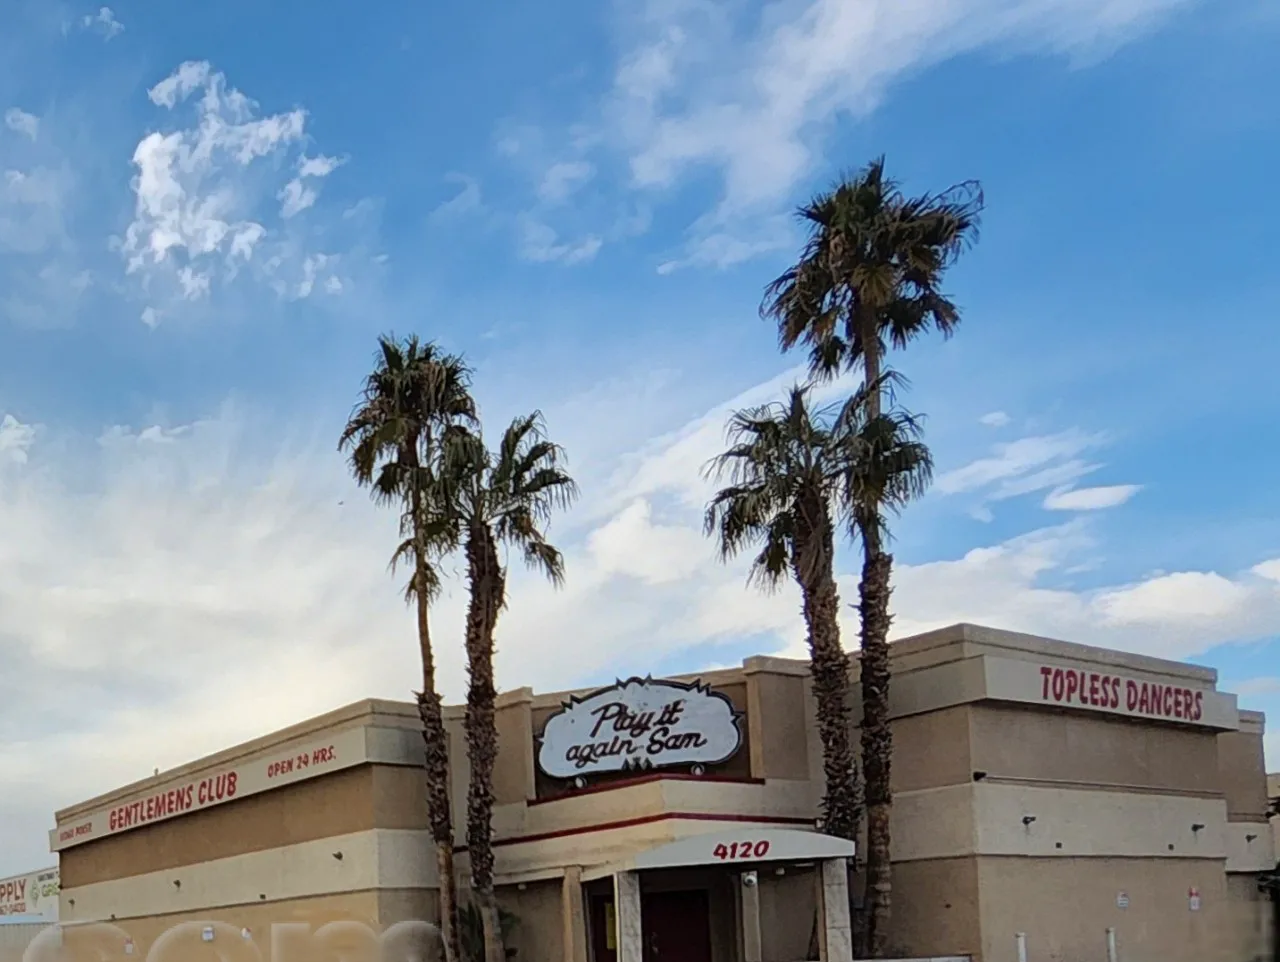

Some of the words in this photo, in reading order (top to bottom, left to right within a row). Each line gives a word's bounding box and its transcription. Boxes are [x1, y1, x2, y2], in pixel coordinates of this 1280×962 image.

[1040, 666, 1121, 709] TOPLESS
[1126, 679, 1203, 721] DANCERS
[590, 701, 656, 738] Play
[652, 699, 687, 727] it
[267, 757, 294, 778] OPEN
[296, 752, 309, 769] 24
[312, 745, 337, 765] HRS.
[565, 735, 638, 769] again
[646, 726, 708, 755] Sam
[109, 783, 194, 831] GENTLEMENS
[198, 771, 238, 805] CLUB
[713, 840, 770, 860] 4120
